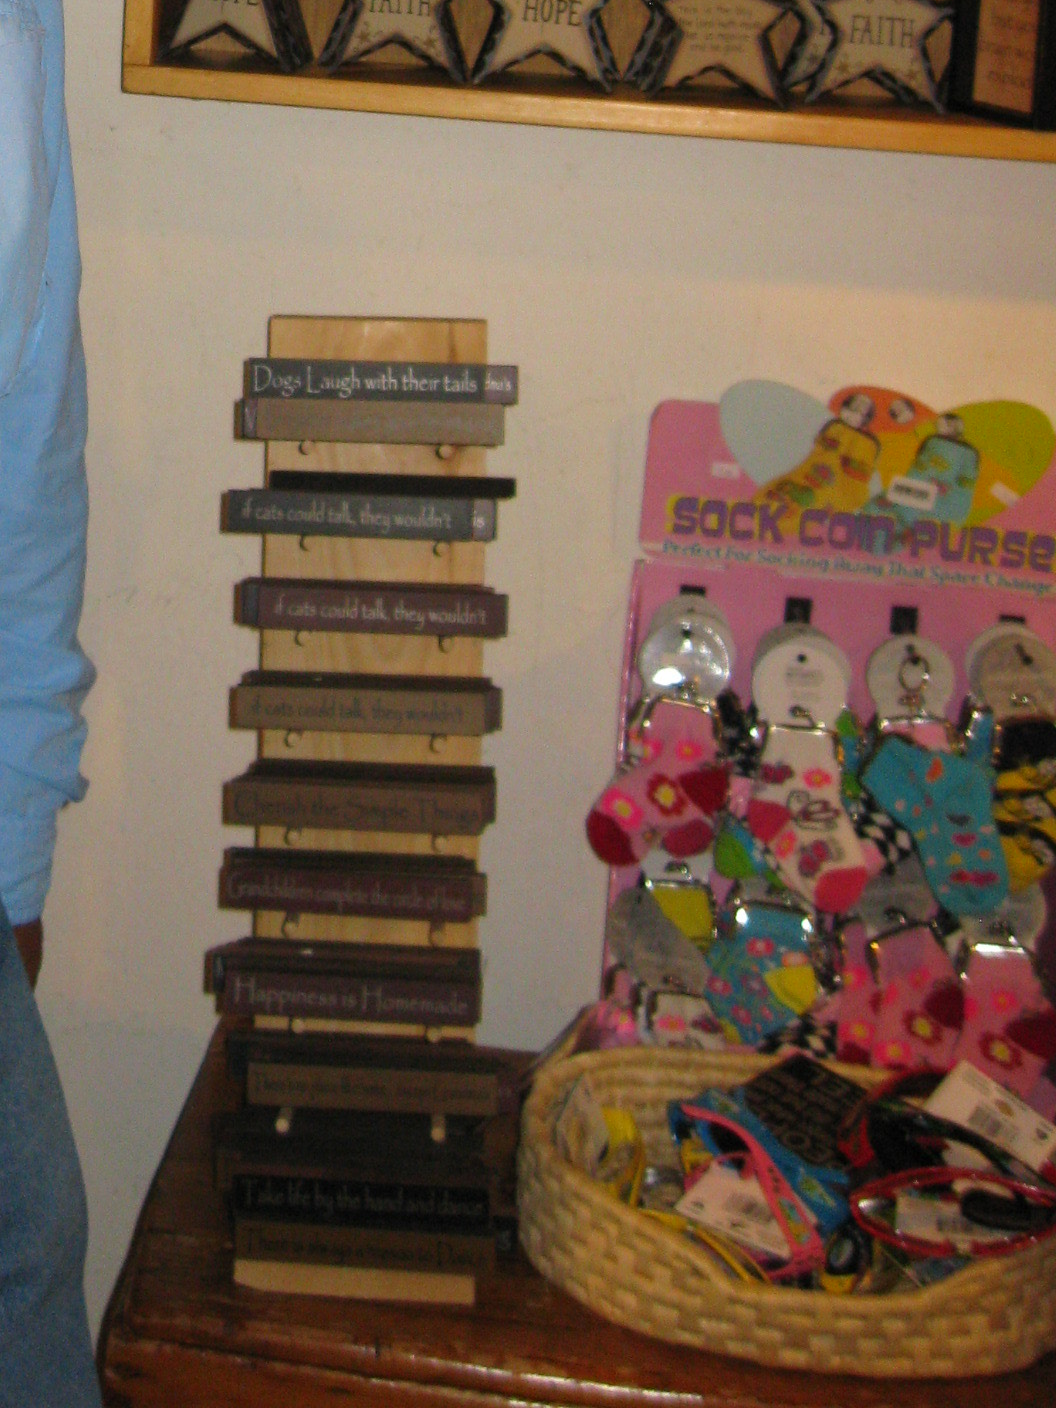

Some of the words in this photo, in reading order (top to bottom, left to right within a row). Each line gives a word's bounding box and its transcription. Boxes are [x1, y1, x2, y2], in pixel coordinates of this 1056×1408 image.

[849, 14, 915, 48] FAITH
[253, 364, 301, 397] Dogs
[306, 366, 360, 398] Laugh
[364, 367, 397, 392] with
[402, 367, 441, 392] their
[444, 369, 478, 392] tails
[668, 496, 789, 545] SOCK
[233, 975, 338, 1012] Happiness
[341, 994, 357, 1008] is
[361, 986, 468, 1015] Homemade
